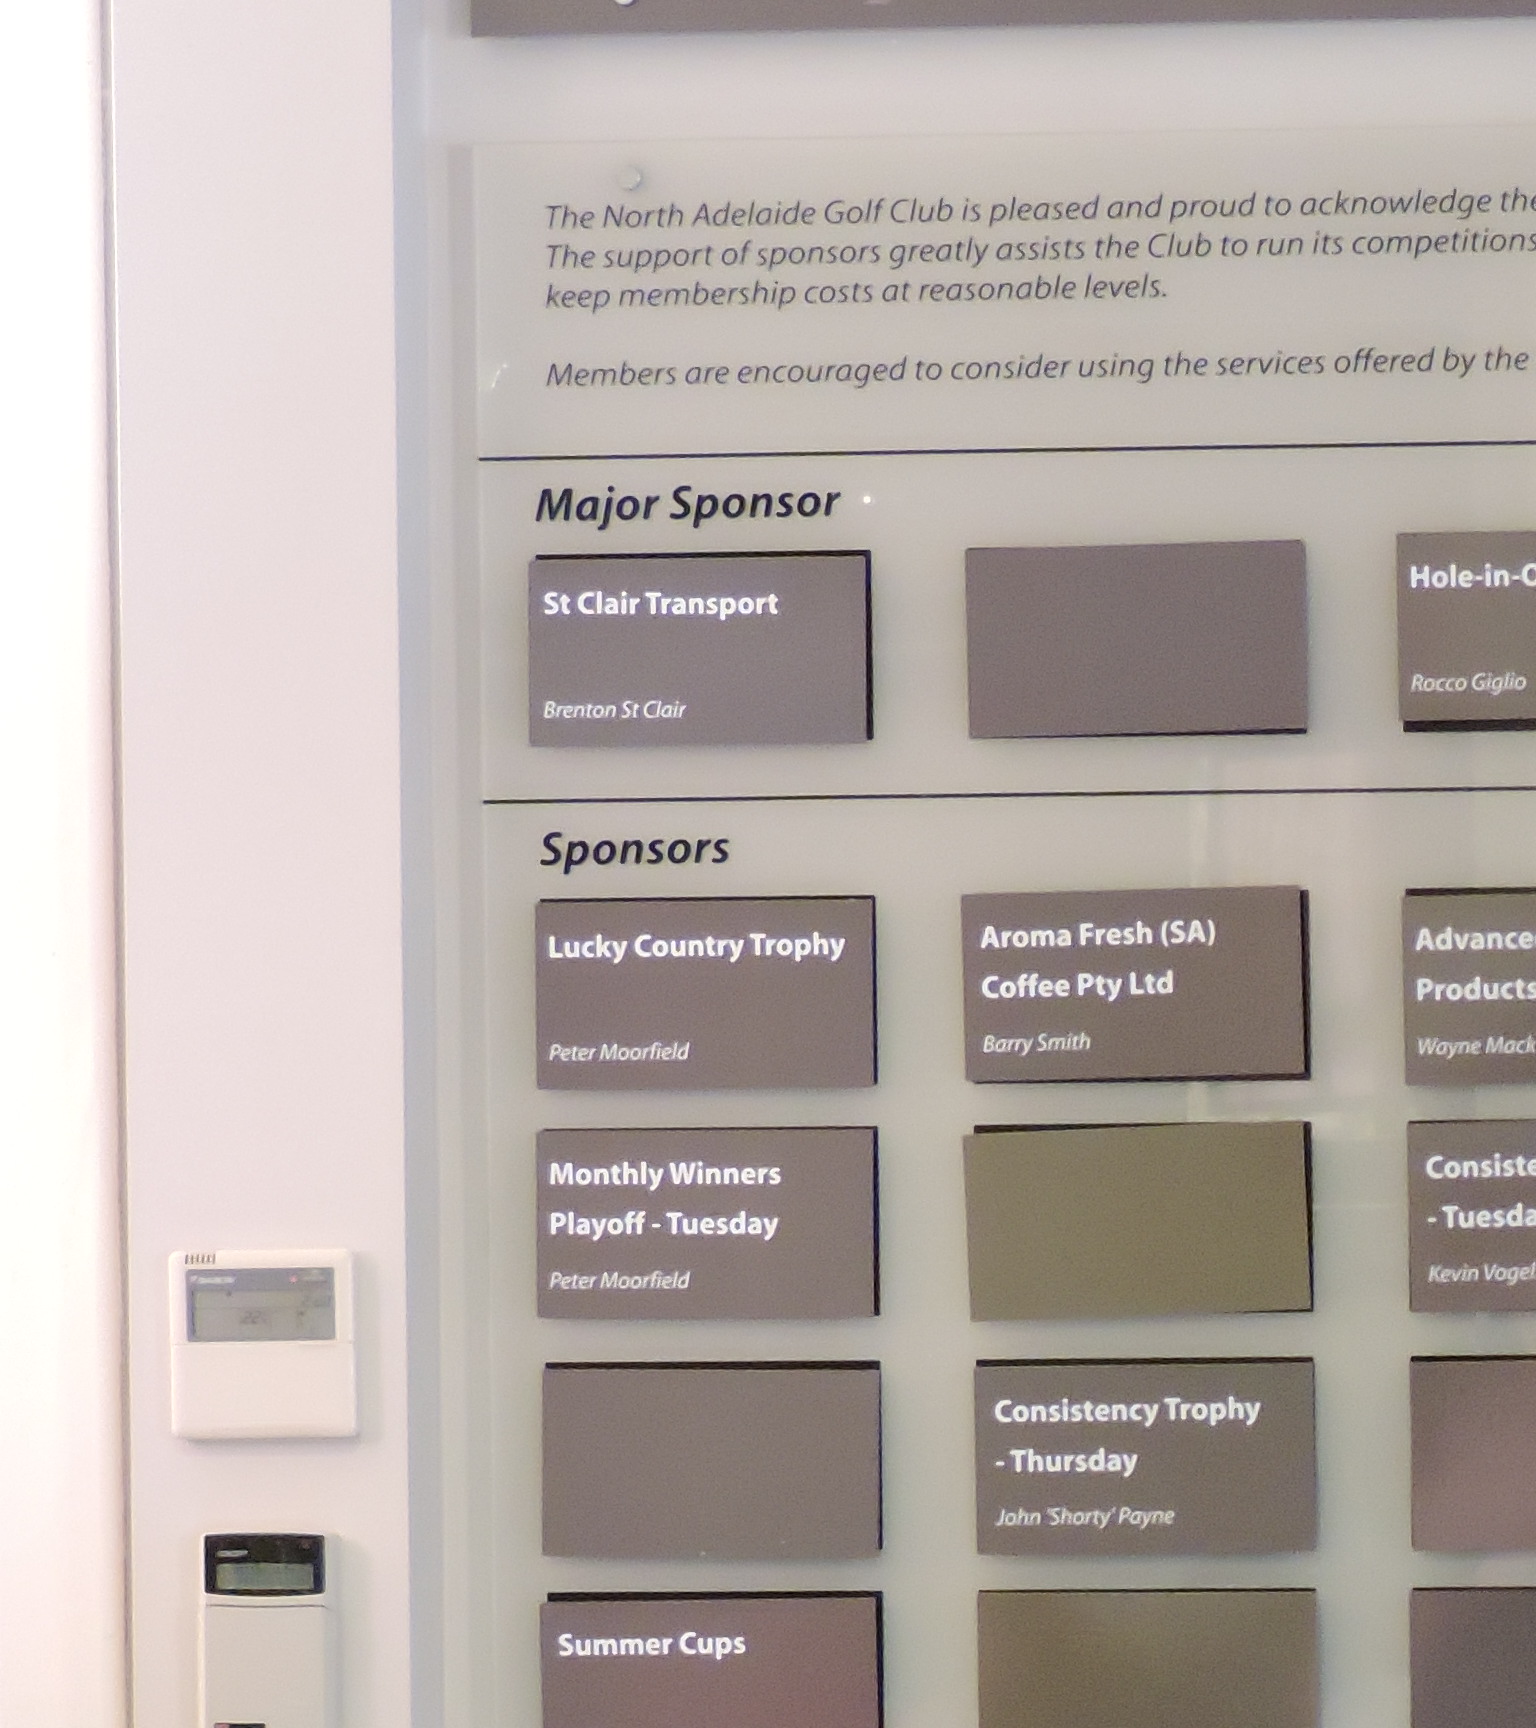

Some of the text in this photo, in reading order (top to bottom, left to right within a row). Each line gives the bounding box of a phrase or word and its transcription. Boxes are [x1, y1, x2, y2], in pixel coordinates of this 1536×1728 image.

[546, 204, 595, 230] The
[602, 202, 684, 229] North
[691, 200, 817, 227] Adelaide
[824, 197, 885, 225] Golf
[890, 197, 954, 224] Club
[962, 197, 981, 223] is
[988, 194, 1100, 228] pleased
[1106, 193, 1164, 220] and
[1169, 191, 1257, 224] proud
[1264, 195, 1292, 217] to
[1299, 188, 1492, 220] acknowledge
[546, 244, 596, 269] The
[602, 245, 713, 274] support
[721, 239, 752, 266] of
[757, 245, 881, 271] sponsors
[889, 236, 990, 271] greatly
[995, 235, 1085, 261] assists
[1095, 233, 1140, 261] the
[1147, 231, 1212, 259] Club
[1221, 236, 1249, 257] to
[1256, 237, 1304, 257] run
[1312, 230, 1343, 256] its
[545, 273, 1167, 315] keep membership costs at reasonable levels.
[546, 361, 676, 387] Members
[684, 365, 730, 385] are
[737, 355, 908, 390] encouraged
[915, 360, 943, 381] to
[950, 353, 1071, 381] consider
[1078, 353, 1155, 384] using
[1163, 351, 1209, 377] the
[1217, 350, 1325, 377] services
[1333, 346, 1436, 374] offered
[1442, 346, 1476, 379] by
[1484, 345, 1530, 372] the
[535, 485, 842, 531] Major Sponsor
[543, 590, 779, 621] St Clair Transport
[543, 700, 687, 719] Brenton St Clair
[539, 831, 730, 875] Sponsors
[548, 931, 846, 964] Lucky Country Trophy
[980, 919, 1216, 949] Aroma Fresh (SA)
[981, 969, 1174, 1002] Coffee Pty Ltd
[549, 1041, 690, 1062] Peter Moorfield
[1418, 1034, 1536, 1060] Wayne Mack
[549, 1160, 782, 1192] Monthly Winners
[550, 1210, 779, 1242] Playoff Tuesday
[1428, 1263, 1480, 1283] Kevin
[994, 1395, 1261, 1428] Consistency Trophy
[1009, 1447, 1138, 1478] Thursday
[995, 1507, 1042, 1527] John
[1118, 1506, 1176, 1530] Payne
[558, 1631, 746, 1661] Summer Cups
